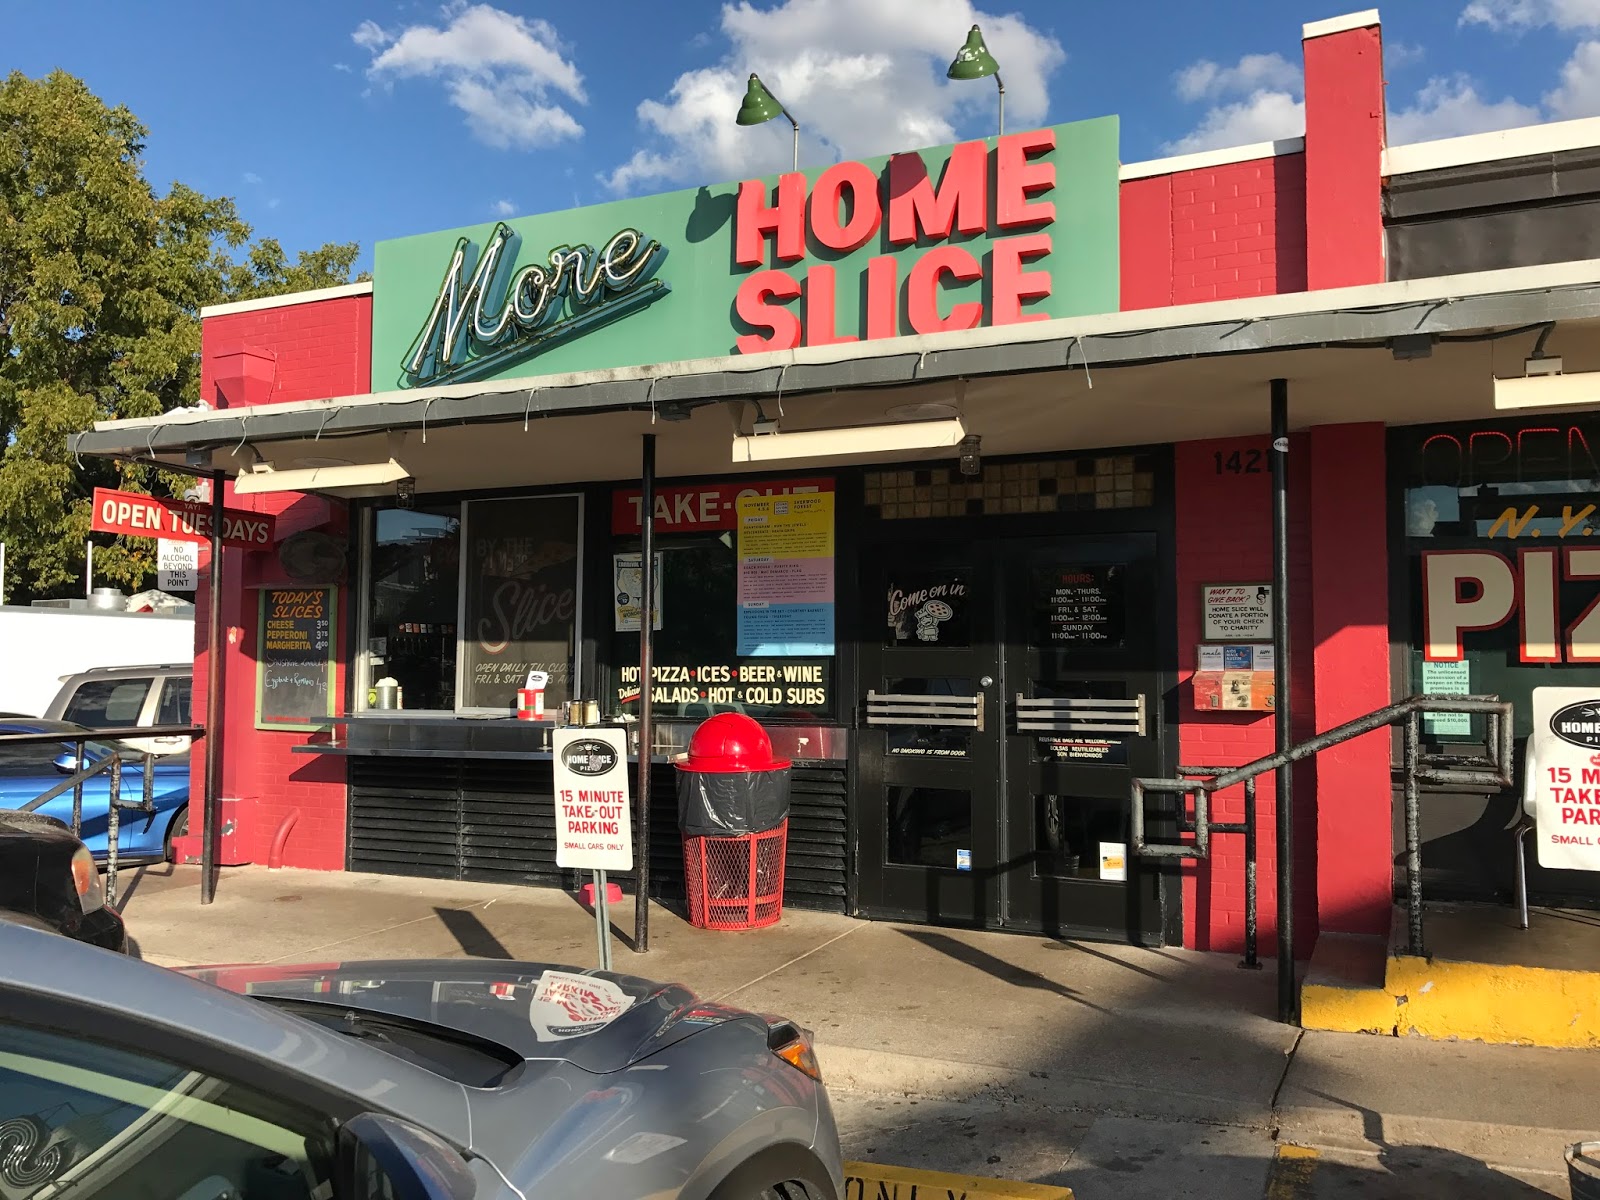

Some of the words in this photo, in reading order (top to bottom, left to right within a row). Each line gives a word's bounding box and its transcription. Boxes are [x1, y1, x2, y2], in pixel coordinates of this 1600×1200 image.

[736, 130, 1056, 266] HOME
[400, 222, 664, 378] More
[736, 233, 1052, 354] SLICE
[628, 486, 819, 526] TAKE-
[102, 500, 161, 530] OPEN
[1487, 504, 1597, 539] N.Y.
[1062, 574, 1095, 583] HOURS:
[272, 591, 323, 605] TODAY'S
[890, 589, 928, 616] Come
[929, 584, 948, 598] on
[950, 579, 966, 596] in
[1226, 595, 1251, 603] BACK?
[272, 605, 323, 619] SLICES
[478, 580, 574, 654] Slice
[267, 620, 294, 629] CHEESE
[266, 630, 308, 640] PEPPERONI
[266, 641, 311, 650] MARGHERITA
[475, 662, 498, 673] OPEN
[500, 662, 527, 672] DAILY
[530, 662, 545, 671] TIL
[652, 666, 691, 682] PIZZA
[697, 666, 730, 682] ICES
[740, 666, 776, 683] BEER
[777, 670, 782, 678] &
[782, 666, 822, 682] WINE
[474, 674, 491, 684] FRI.
[494, 674, 500, 684] &
[503, 674, 523, 684] SAT.
[618, 685, 640, 699] Deliciou
[708, 687, 735, 703] HOT
[737, 691, 744, 699] &
[746, 687, 783, 704] COLD
[786, 687, 825, 704] SUBS
[1237, 695, 1248, 707] 2
[1561, 722, 1600, 733] HOME
[566, 755, 588, 764] HOME
[1547, 767, 1572, 783] 15
[560, 790, 573, 802] 15
[578, 790, 624, 803] MINUTE
[562, 805, 623, 819] TAKE-OUT
[568, 821, 619, 834] PARKING
[1551, 835, 1593, 845] SMALL
[845, 1177, 968, 1200] ON
